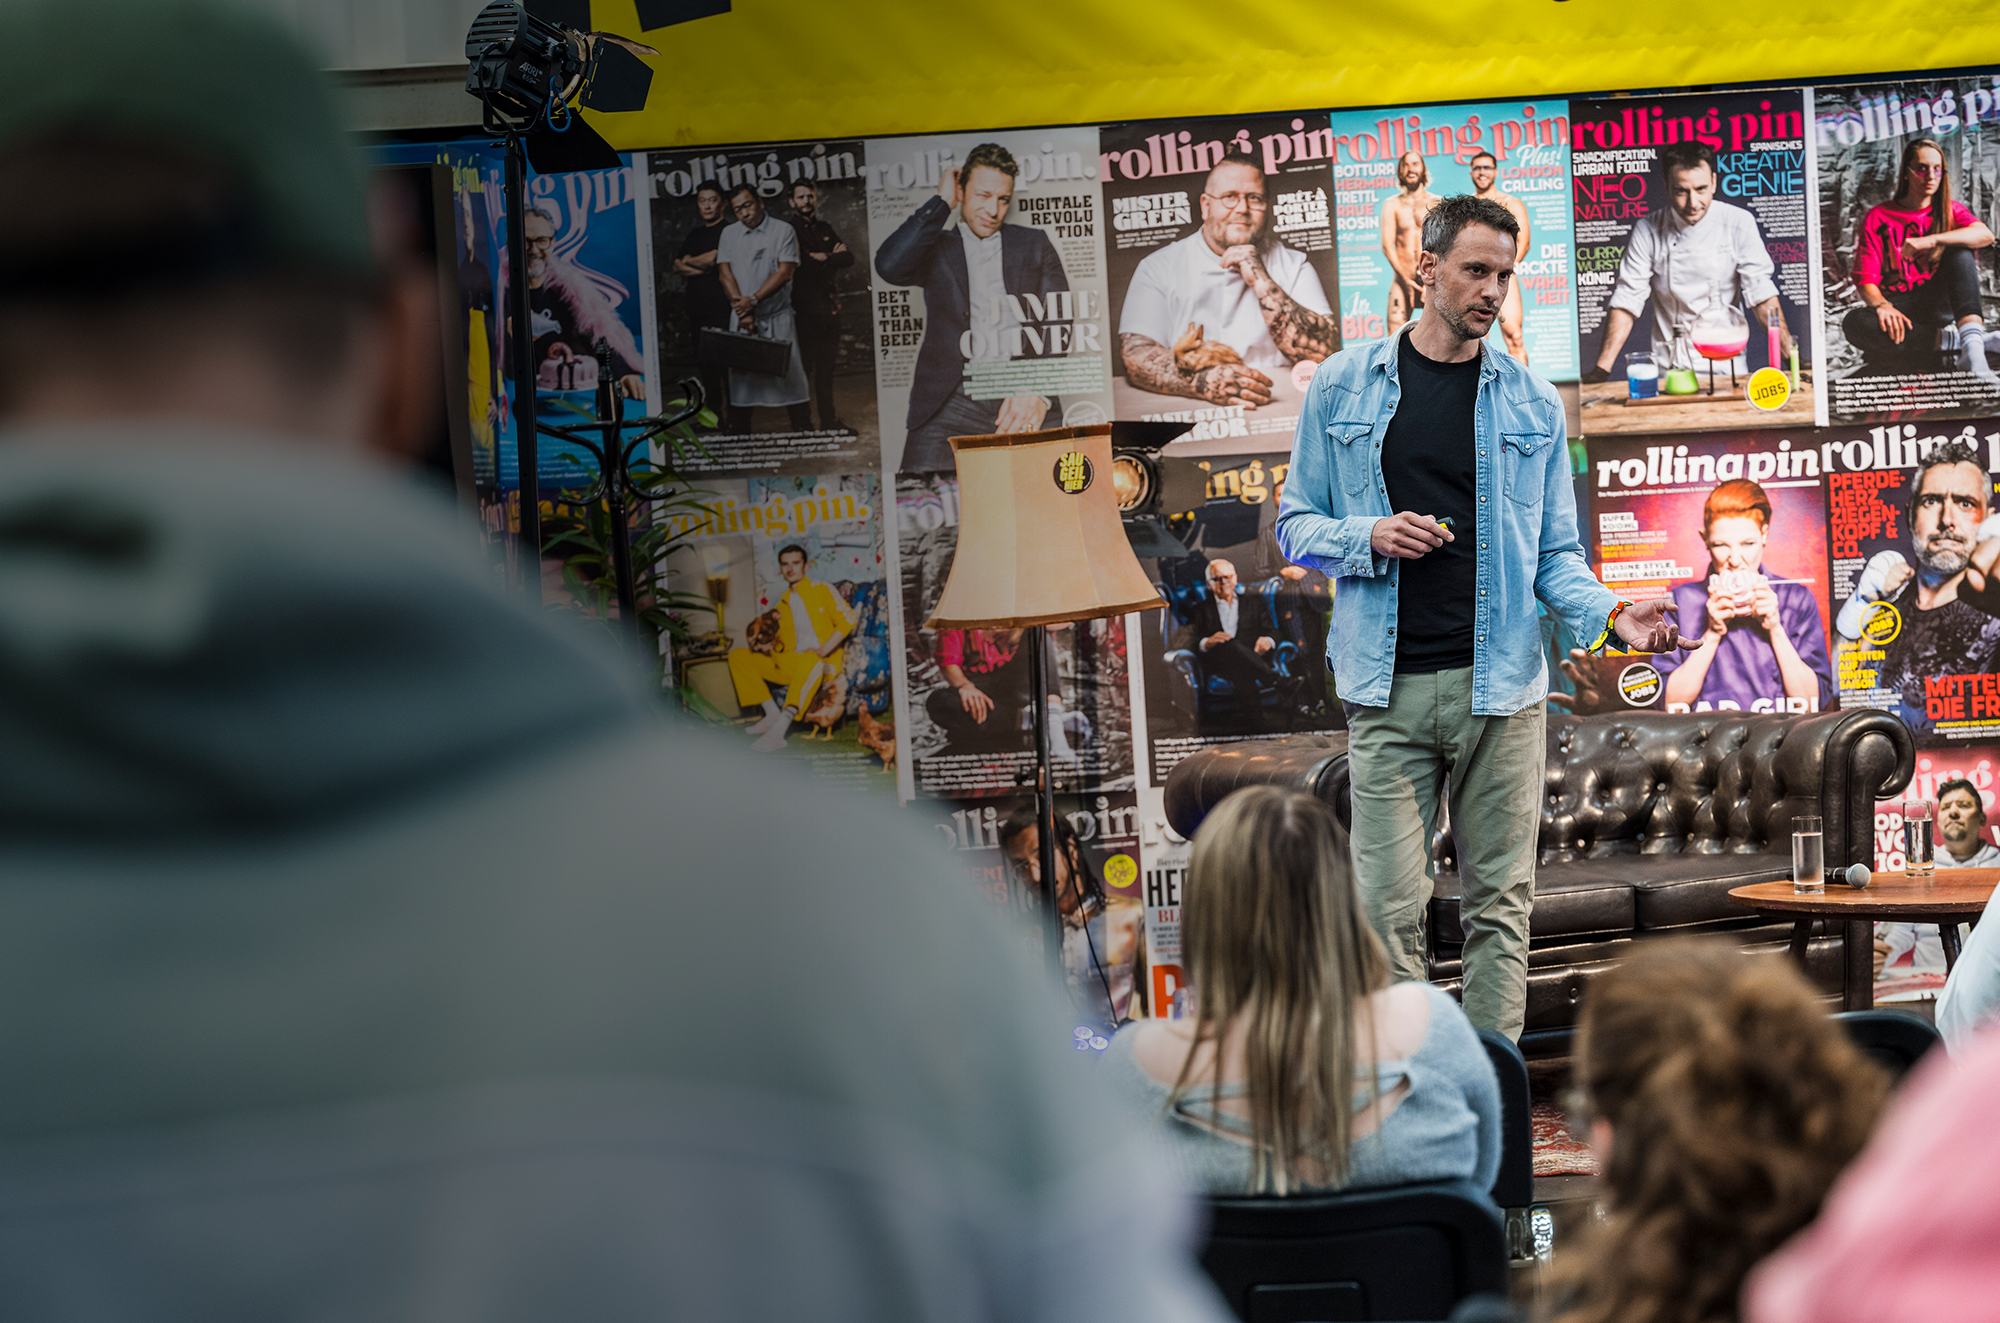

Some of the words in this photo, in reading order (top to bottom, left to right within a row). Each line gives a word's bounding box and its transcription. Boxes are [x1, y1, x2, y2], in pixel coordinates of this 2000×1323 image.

[518, 61, 540, 76] ARRI
[1815, 88, 1960, 146] rolling
[1571, 105, 1723, 152] rolling
[1727, 99, 1804, 152] pin
[1332, 116, 1487, 166] rolling
[1490, 107, 1571, 161] pin
[1258, 117, 1334, 175] pin
[1516, 136, 1567, 168] Plus!
[1749, 141, 1803, 152] SPANISCHES
[1334, 162, 1396, 178] BOTTURA
[1573, 162, 1615, 176] URBAN
[1716, 150, 1805, 174] KREATIV
[648, 152, 786, 199] rolling
[787, 143, 869, 186] pin.
[1501, 165, 1565, 179] LONDON
[1334, 176, 1397, 191] HERMAN
[1502, 177, 1566, 193] CALLING
[1573, 174, 1647, 203] NEO
[1721, 169, 1805, 197] GENIE
[1019, 195, 1093, 213] DIGITALE
[1112, 191, 1191, 214] MISTER
[1335, 190, 1379, 204] TRETTL
[1272, 200, 1330, 216] PORTER
[1335, 204, 1375, 217] RAUE
[1574, 201, 1649, 220] NATURE
[1031, 210, 1094, 226] REVOLU
[1113, 206, 1193, 231] GREEN
[1336, 217, 1381, 231] ROSIN
[1055, 224, 1094, 238] TION
[1541, 243, 1568, 259] DIE
[1576, 246, 1625, 261] CURRY
[1766, 241, 1807, 254] CRAZY
[1577, 258, 1621, 273] WURST
[1522, 275, 1569, 290] WAHR
[1578, 271, 1615, 285] KÖNIG
[878, 290, 910, 304] BET
[1536, 289, 1571, 306] HEIT
[878, 304, 911, 318] TER
[990, 289, 1101, 326] JAMIE
[879, 317, 924, 332] THAN
[1342, 314, 1385, 340] BIG
[880, 333, 921, 347] BEEF
[959, 323, 1103, 360] OLIVER
[881, 348, 889, 359] ?
[1753, 382, 1786, 401] JOBS
[1194, 405, 1246, 422] STATT
[1059, 451, 1085, 468] SAU
[1746, 439, 1820, 485] pin
[1059, 466, 1086, 482] GEIL
[1829, 469, 1906, 491] PFERDE-
[1063, 480, 1084, 491] HIER
[791, 488, 869, 534] pin.
[1830, 503, 1902, 525] ZIEGEN-
[1832, 521, 1882, 541] KOPF
[1885, 520, 1899, 539] &
[1832, 540, 1864, 559] CO.
[1604, 563, 1640, 572] CUISINE
[1643, 562, 1671, 570] STYLE
[1643, 570, 1669, 578] AGED
[1838, 650, 1886, 662] ARBEITEN
[1838, 660, 1859, 671] AUF
[1838, 678, 1876, 690] SAISON
[1926, 696, 1966, 720] DIE
[1875, 812, 1904, 831] OD
